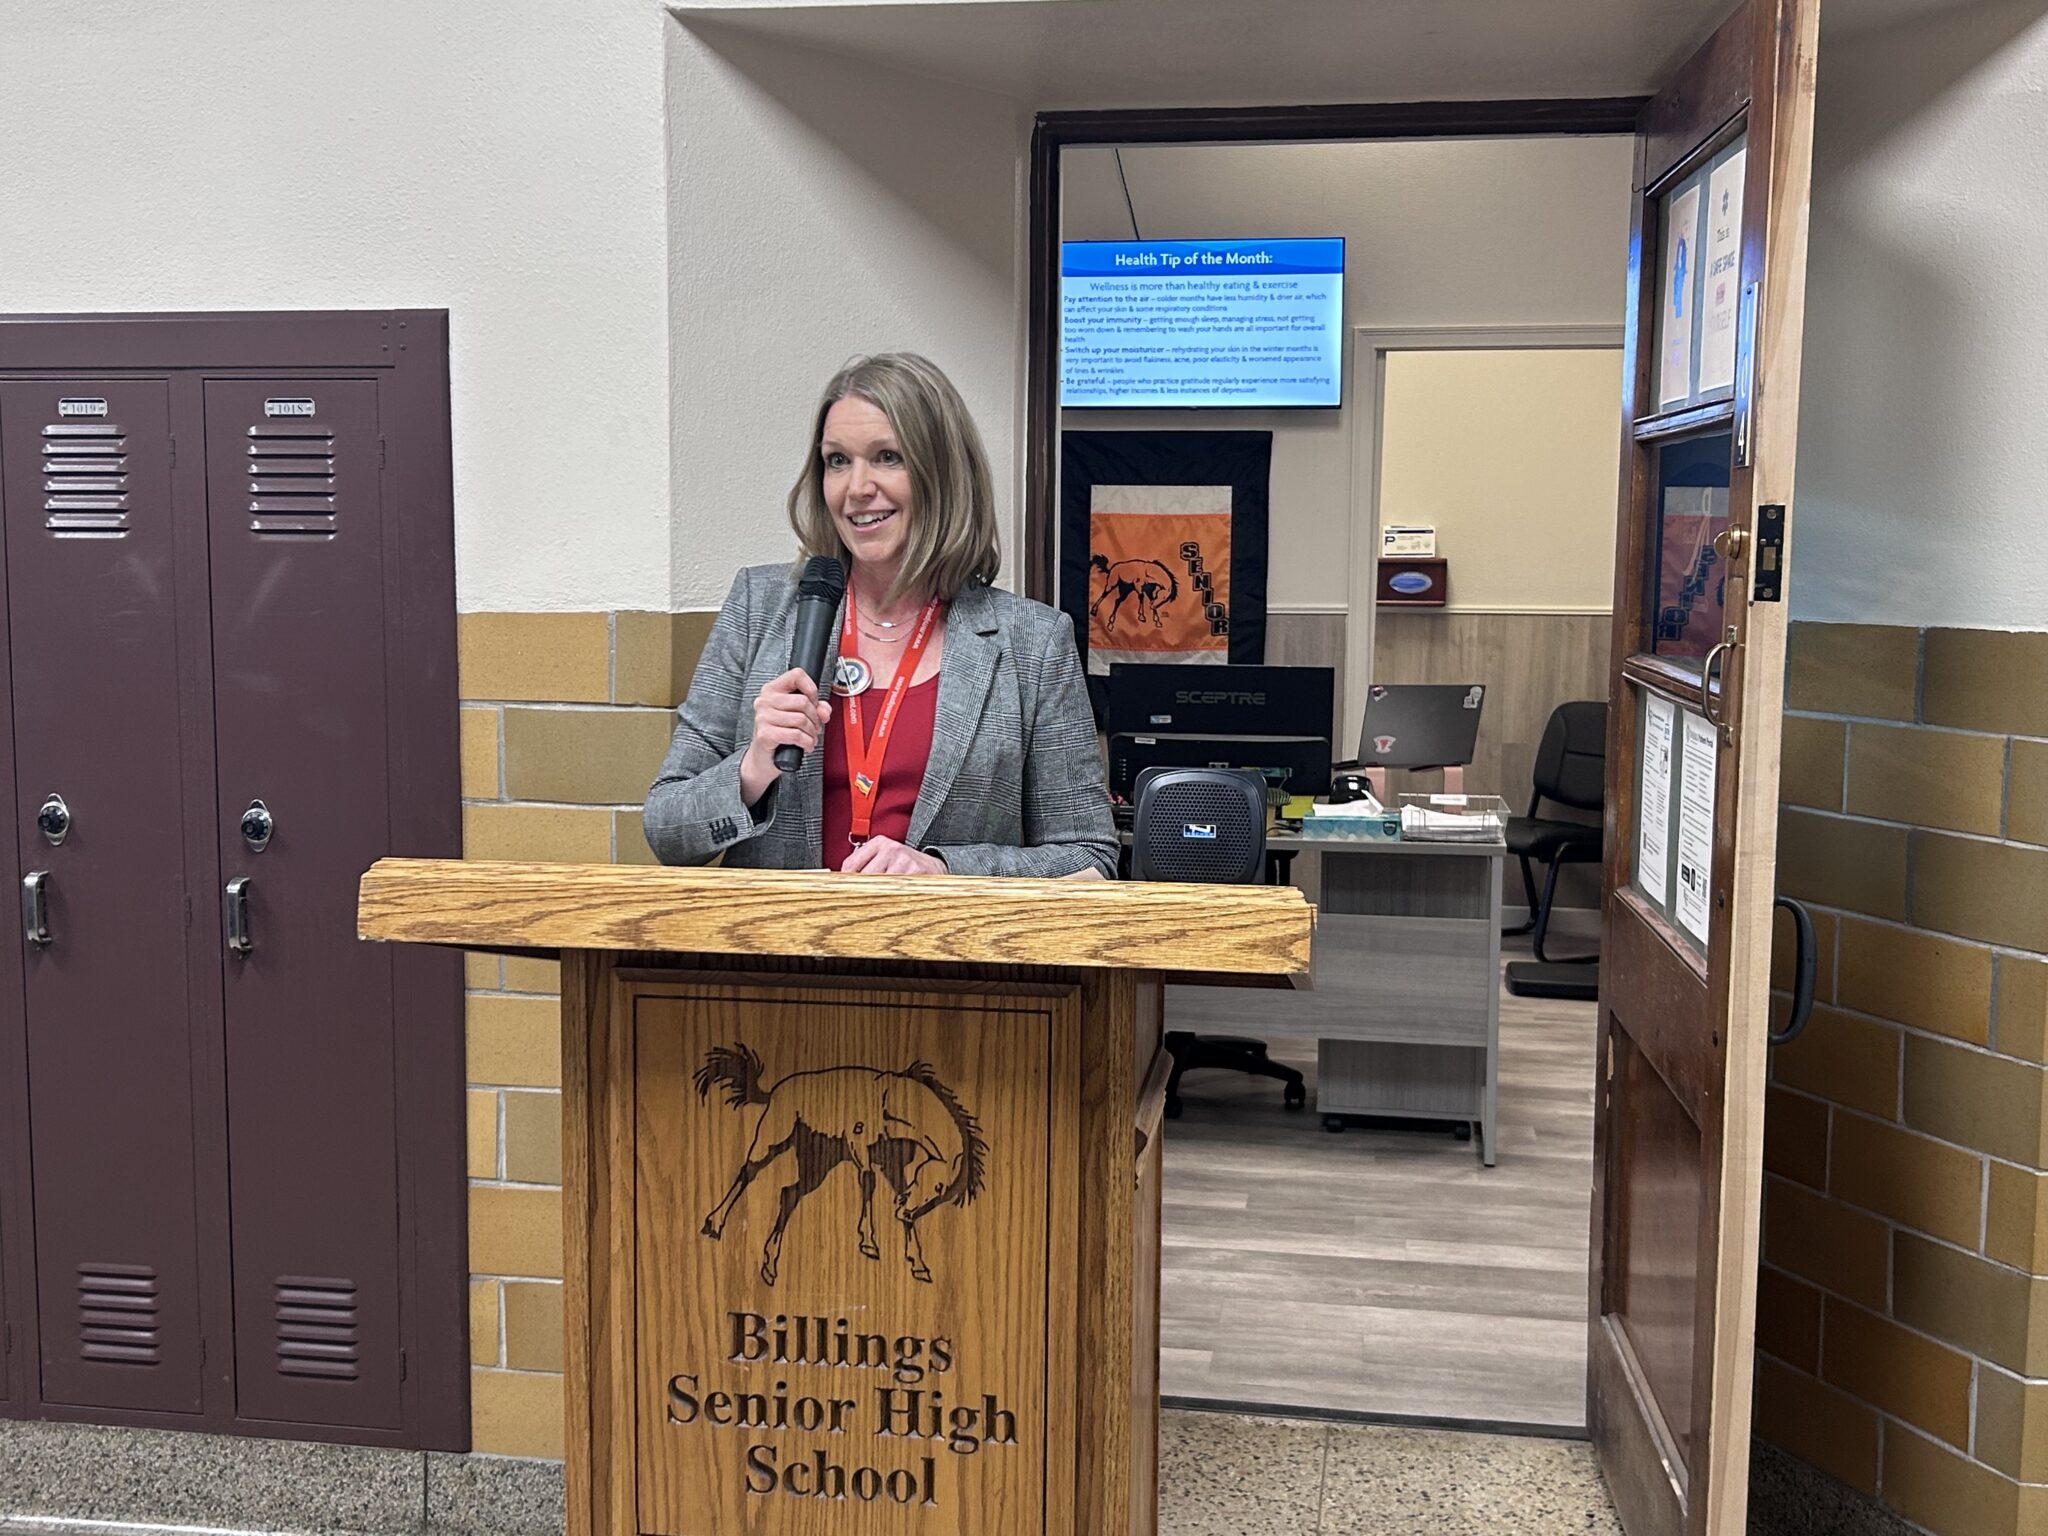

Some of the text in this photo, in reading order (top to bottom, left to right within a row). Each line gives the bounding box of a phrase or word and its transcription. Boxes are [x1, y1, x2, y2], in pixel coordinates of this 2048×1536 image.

[1115, 251, 1273, 268] Health Tip of the Month:
[1090, 282, 1129, 291] Wellness
[1131, 283, 1138, 291] is
[1165, 281, 1186, 290] than
[1187, 281, 1220, 292] healthy
[1223, 281, 1251, 292] eating
[1253, 281, 1260, 289] &
[1262, 281, 1298, 289] exercise
[1064, 296, 1076, 304] Pay
[1238, 294, 1267, 302] humidity
[1155, 305, 1190, 313] respiratory
[1192, 304, 1228, 312] conditions
[1087, 317, 1104, 325] your
[1106, 316, 1142, 325] immunity
[1149, 316, 1173, 325] getting
[1175, 316, 1200, 324] enough
[1291, 315, 1315, 323] getting
[1123, 326, 1167, 334] remembering
[1196, 326, 1211, 334] your
[1255, 325, 1289, 333] important
[1171, 346, 1209, 354] rehydrating
[1211, 346, 1226, 354] your
[1077, 377, 1106, 386] grateful
[1113, 378, 1136, 386] people
[1181, 377, 1210, 386] gratitude
[1212, 377, 1240, 385] regularly
[72, 404, 96, 413] 1019
[279, 404, 304, 414] 1018
[1180, 542, 1229, 636] SENIOR
[1175, 691, 1266, 705] SCEPTRE
[728, 1312, 952, 1384] Billings
[667, 1375, 1018, 1454] Senior High
[745, 1445, 938, 1507] School
